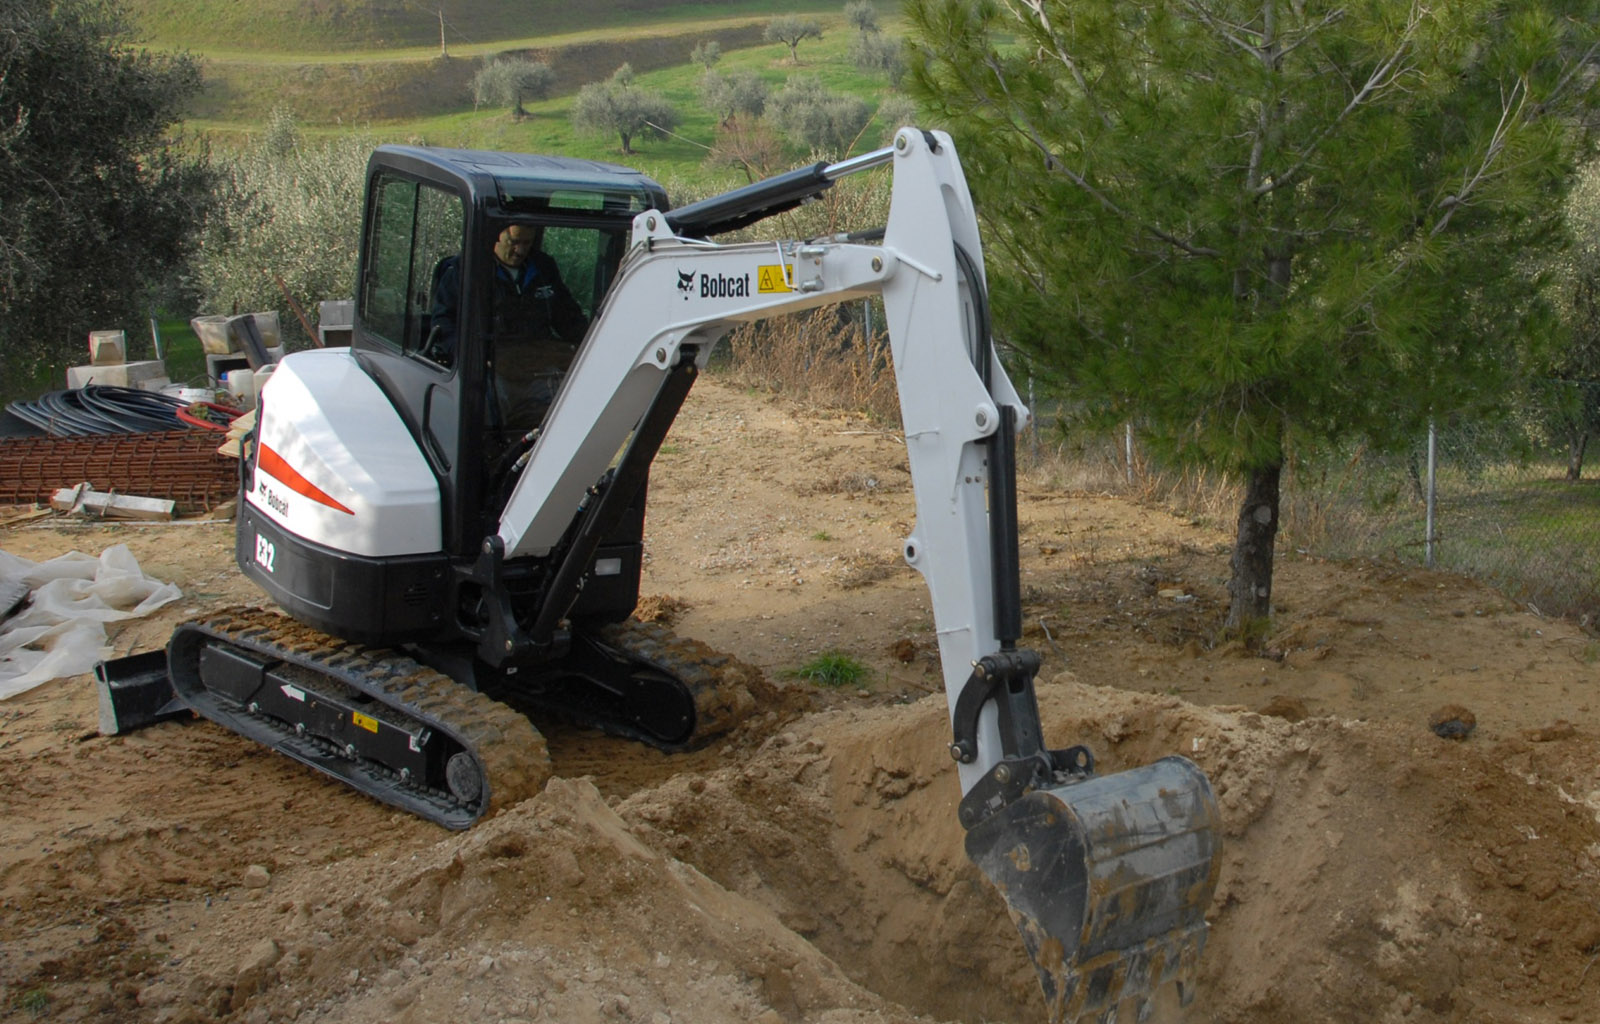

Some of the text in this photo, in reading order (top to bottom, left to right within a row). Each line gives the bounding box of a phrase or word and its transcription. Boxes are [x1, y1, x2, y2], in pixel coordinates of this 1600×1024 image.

[700, 273, 750, 298] Bobcat
[267, 489, 289, 518] Bobcat
[255, 533, 275, 573] E32
